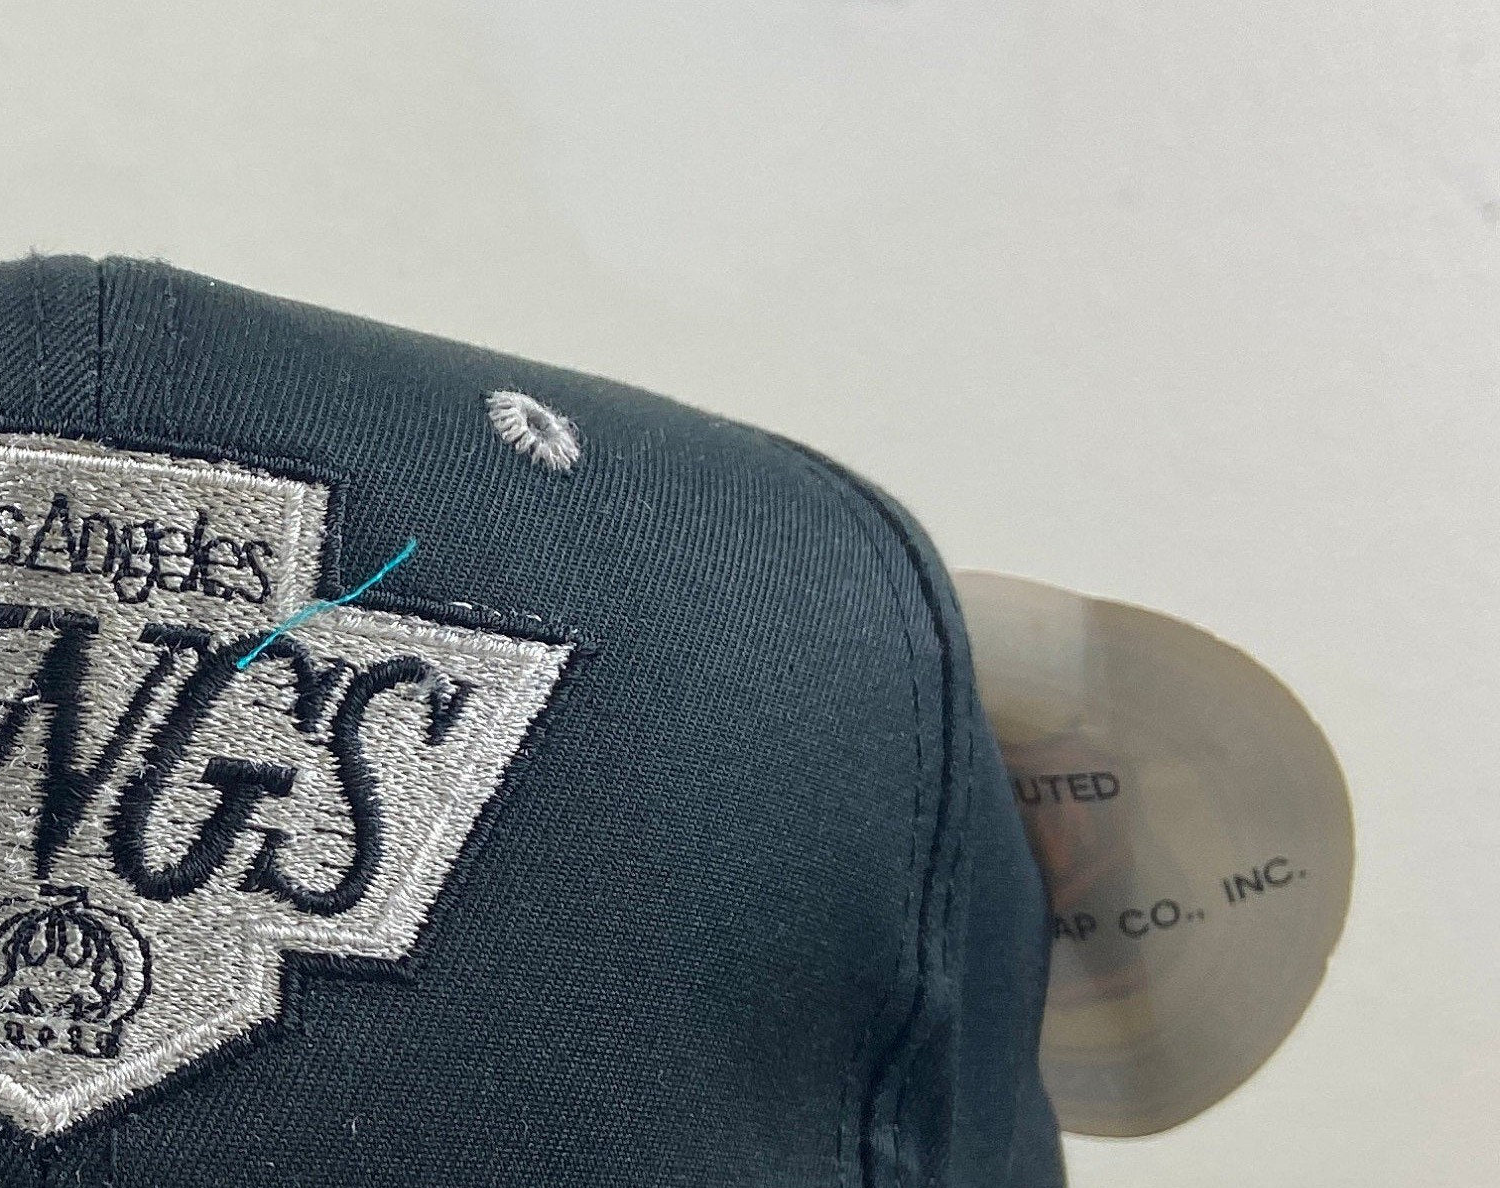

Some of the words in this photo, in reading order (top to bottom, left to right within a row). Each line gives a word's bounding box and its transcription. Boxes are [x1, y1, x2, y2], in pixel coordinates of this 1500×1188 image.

[26, 493, 276, 604] Angeles
[1118, 898, 1206, 940] CO.,
[1219, 855, 1307, 906] INC.
